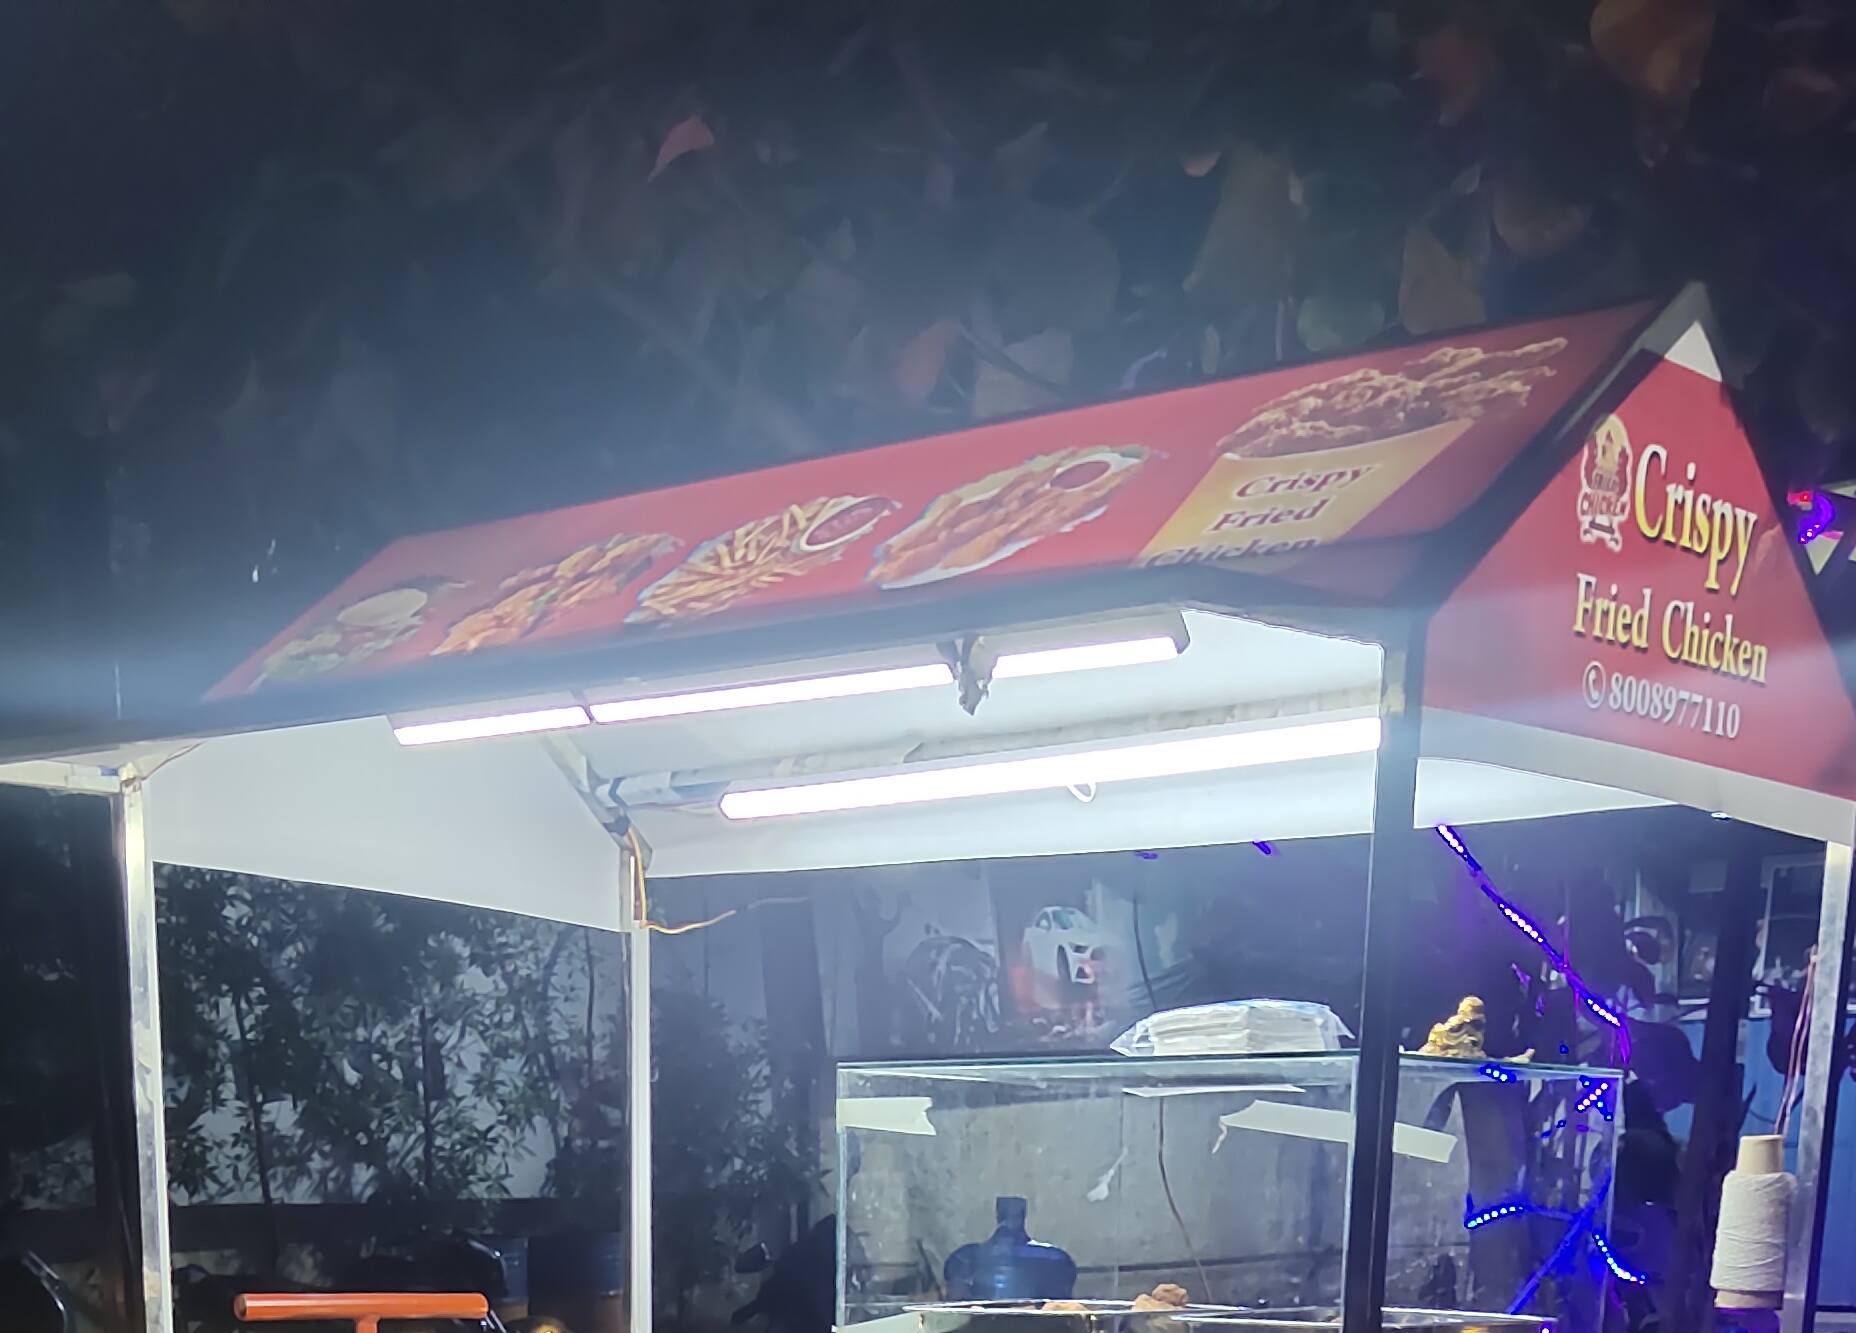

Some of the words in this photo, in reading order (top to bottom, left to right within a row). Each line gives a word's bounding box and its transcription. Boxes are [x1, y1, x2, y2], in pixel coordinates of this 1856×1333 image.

[1235, 463, 1381, 499] Crispy
[1205, 496, 1336, 533] Fried
[1635, 443, 1758, 597] Crispy
[1144, 538, 1321, 568] Chicken
[1573, 573, 1653, 649] Fried
[1661, 600, 1769, 684] Chicken
[1609, 671, 1741, 739] 8008977110
